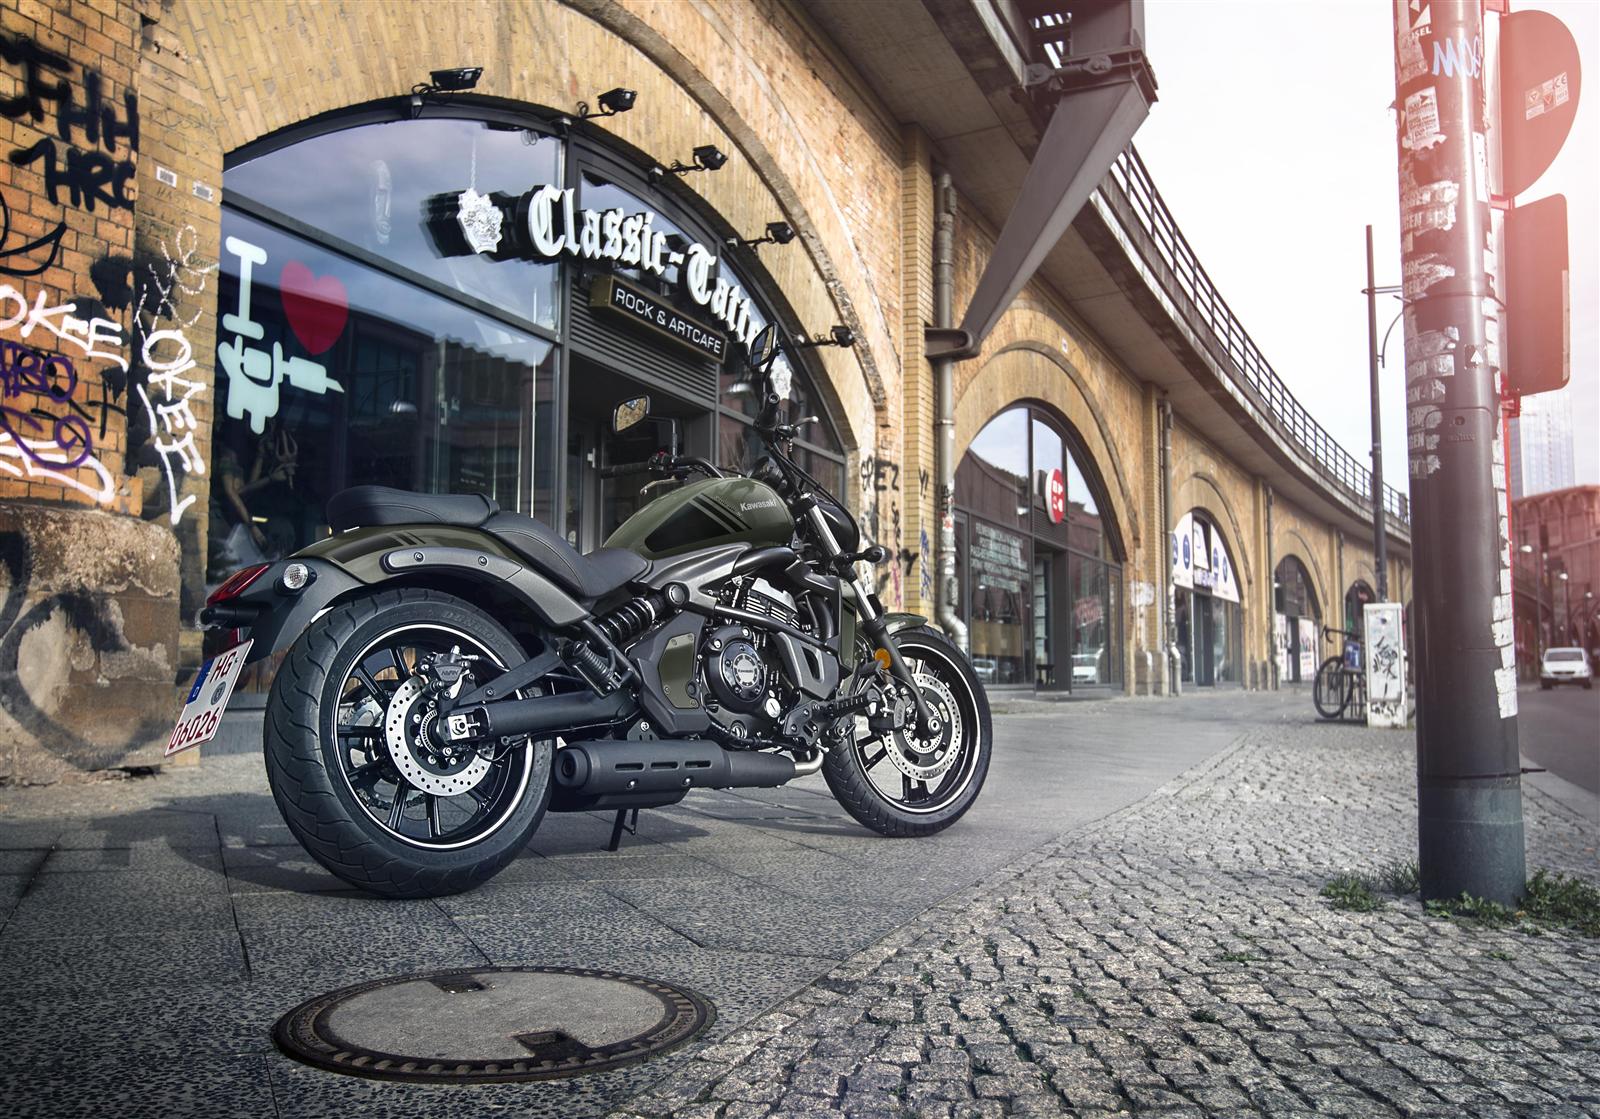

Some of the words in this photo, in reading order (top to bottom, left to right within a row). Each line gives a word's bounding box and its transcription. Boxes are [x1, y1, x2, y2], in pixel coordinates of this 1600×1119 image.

[615, 287, 654, 320] ROCK
[656, 310, 666, 325] &
[668, 317, 722, 354] ARTCAFE
[740, 498, 777, 511] Kawasaki
[209, 651, 237, 684] HG
[168, 706, 222, 750] 06026
